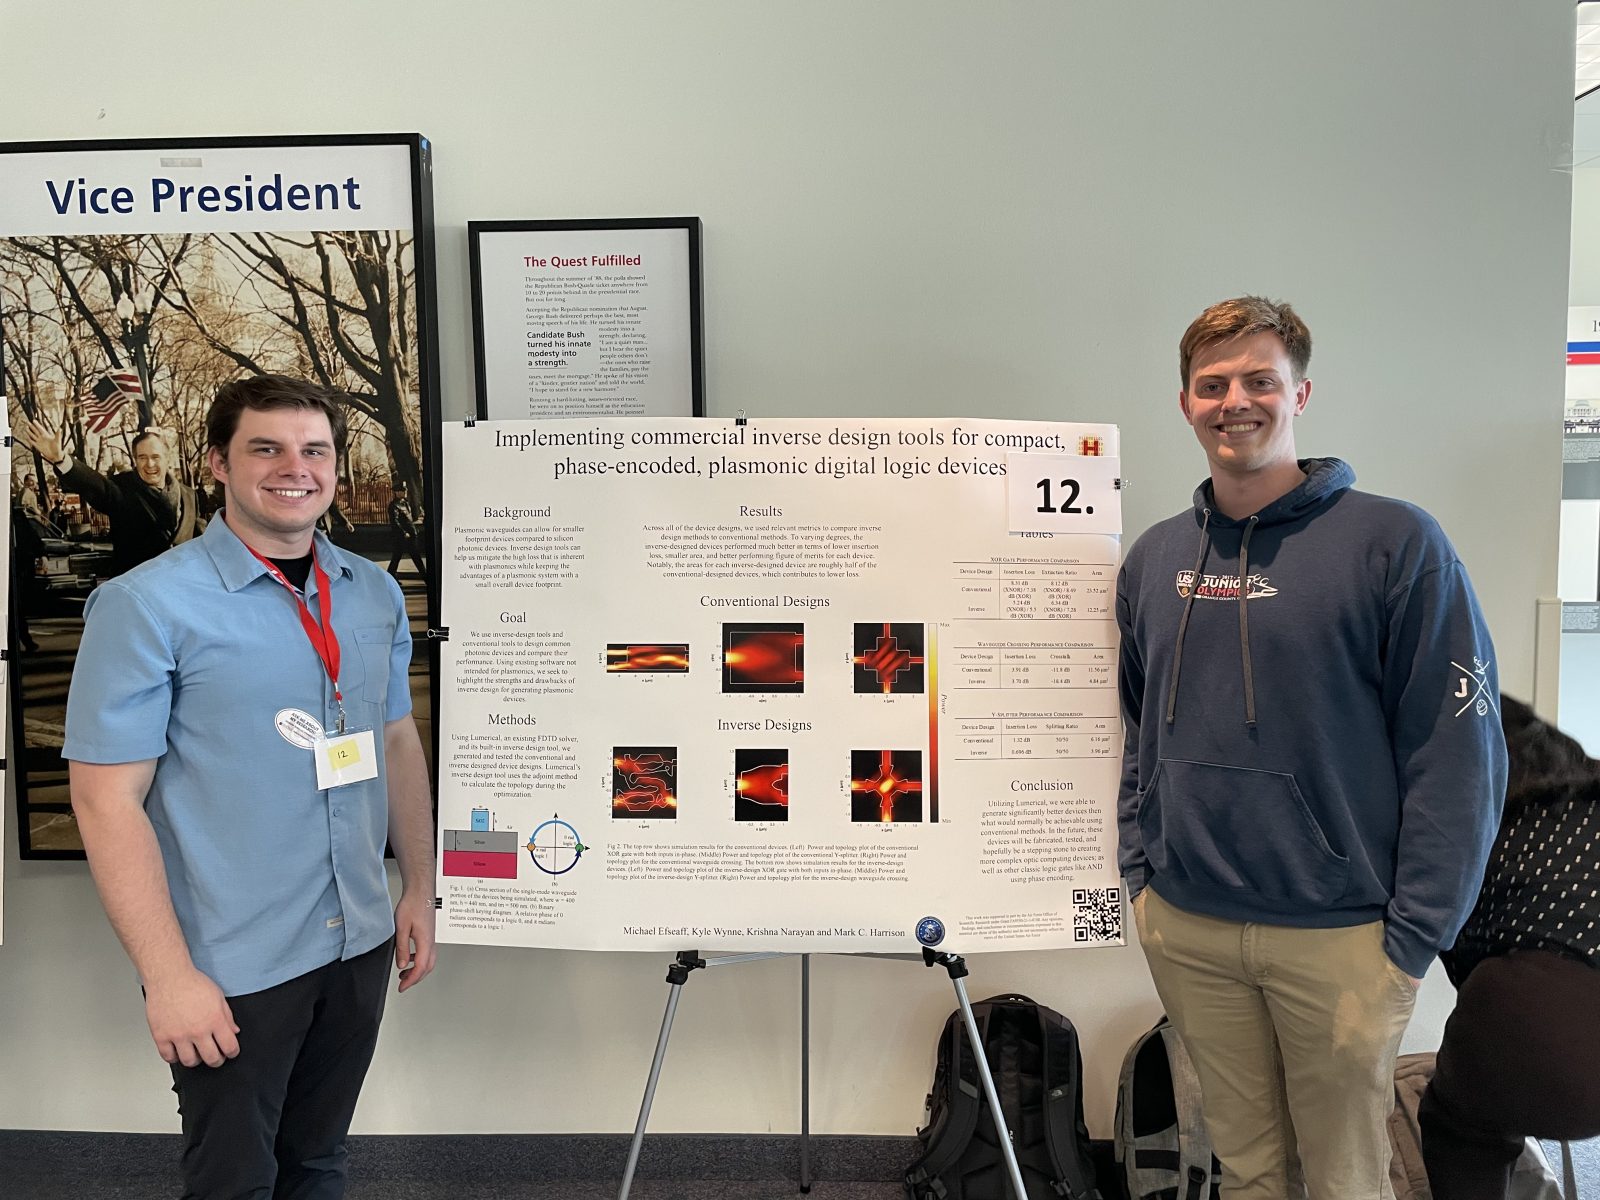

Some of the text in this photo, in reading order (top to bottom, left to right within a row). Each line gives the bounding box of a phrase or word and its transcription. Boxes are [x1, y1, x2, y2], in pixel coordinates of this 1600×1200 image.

[45, 173, 361, 215] Vice President
[524, 254, 641, 269] The Quest Fulfilled
[526, 331, 565, 339] Candidate
[527, 350, 560, 358] modesty
[534, 359, 568, 367] strength.
[495, 427, 1066, 452] Implementing commercial inverse design tools for compact,
[554, 456, 1007, 479] phase-encoded, plasmonic digital logic devices
[1036, 478, 1094, 515] 12.
[484, 506, 551, 520] Background
[740, 505, 783, 517] Results
[486, 526, 521, 534] waveguides
[717, 525, 743, 533] designs,
[460, 572, 492, 580] advantages
[506, 572, 537, 580] plasmonic
[1197, 586, 1250, 597] OLYMPI
[700, 595, 830, 609] Conventional Designs
[500, 611, 526, 623] Goal
[500, 668, 536, 676] plasmonics,
[456, 677, 483, 685] highlight
[495, 677, 522, 685] strengths
[1455, 678, 1467, 697] J
[488, 713, 536, 725] Methods
[717, 719, 812, 733] Inverse Designs
[451, 735, 469, 743] Using
[525, 745, 546, 753] design
[338, 751, 348, 759] 12
[1011, 779, 1074, 792] Conclusion
[1008, 809, 1045, 817] significantly
[1042, 866, 1057, 874] logic
[623, 927, 905, 938] Michael Efseaff, Kyle Wynne, Krishna Narayan and Mark C. Harrison
